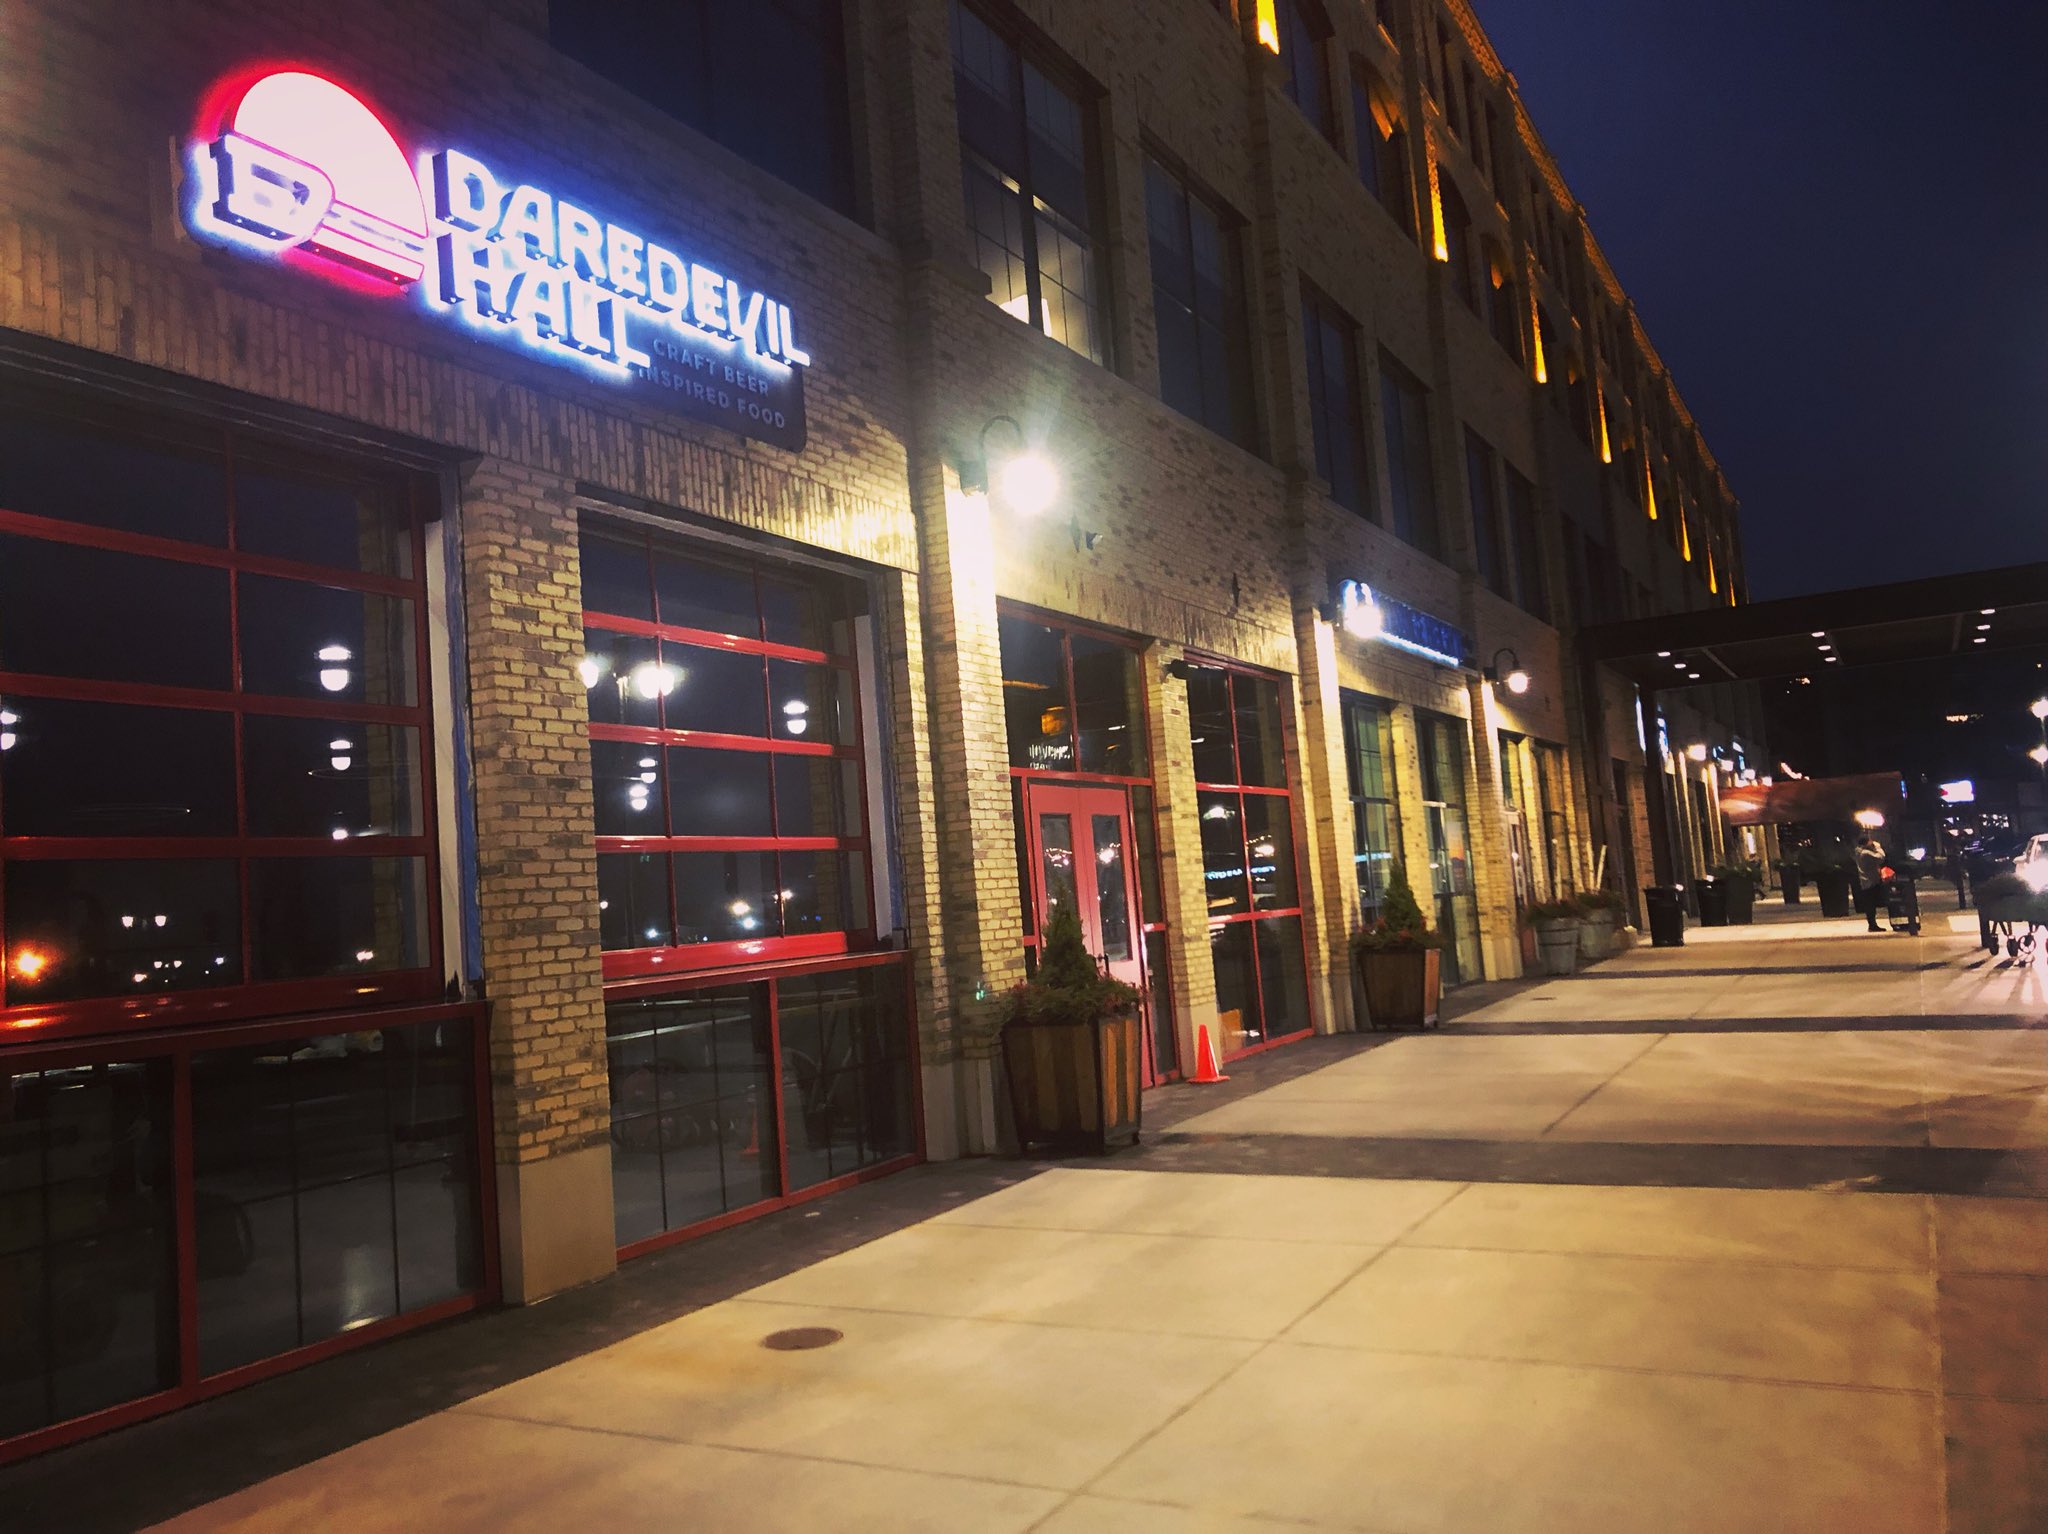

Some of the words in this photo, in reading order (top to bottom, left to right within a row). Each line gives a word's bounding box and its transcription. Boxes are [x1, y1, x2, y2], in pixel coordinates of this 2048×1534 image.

[435, 148, 811, 367] DAREDEVIL
[438, 234, 650, 368] HALL
[639, 366, 729, 408] INSPIRED
[738, 398, 785, 429] FOOD
[653, 339, 715, 376] CRAFT
[724, 365, 769, 396] BEER
